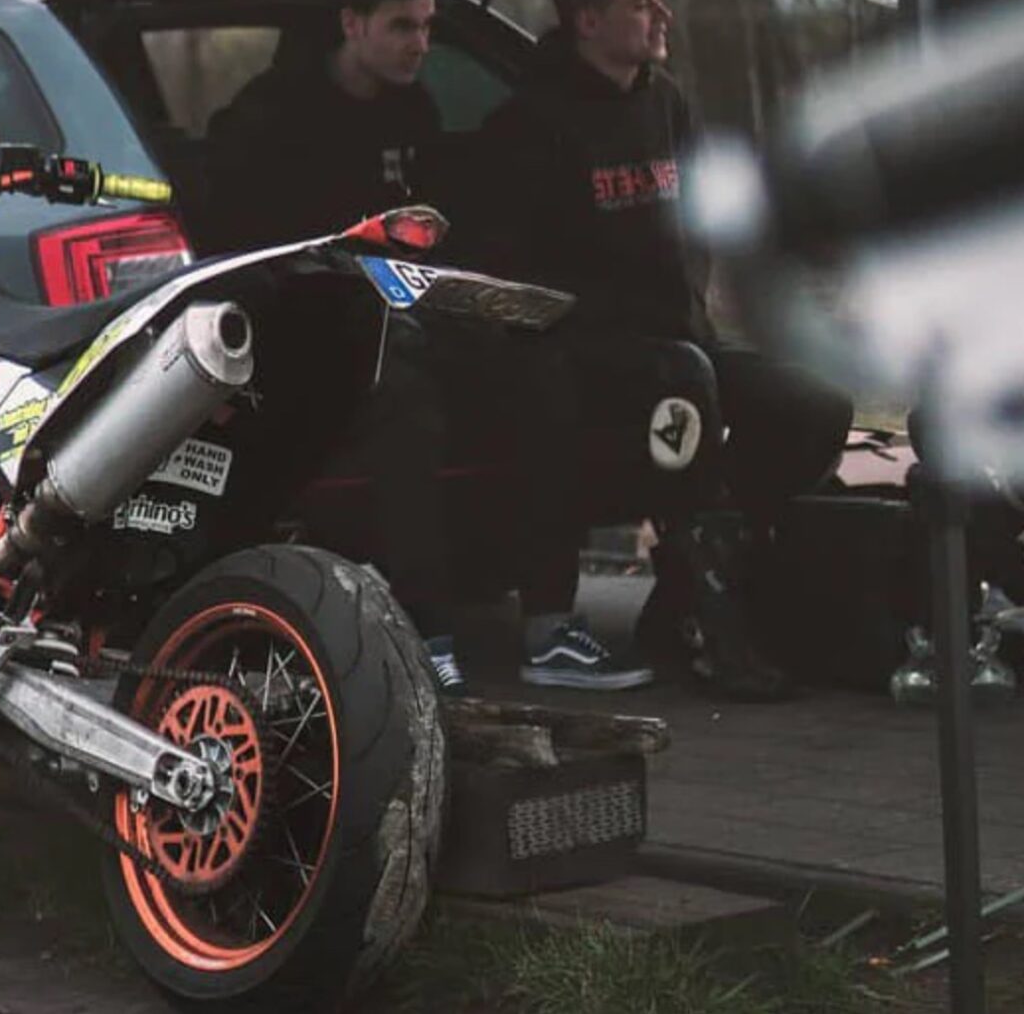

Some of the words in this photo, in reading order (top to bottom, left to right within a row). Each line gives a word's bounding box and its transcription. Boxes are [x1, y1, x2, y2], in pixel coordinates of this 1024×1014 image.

[186, 443, 227, 463] HAND
[184, 456, 225, 477] WASH
[180, 468, 220, 487] ONLY
